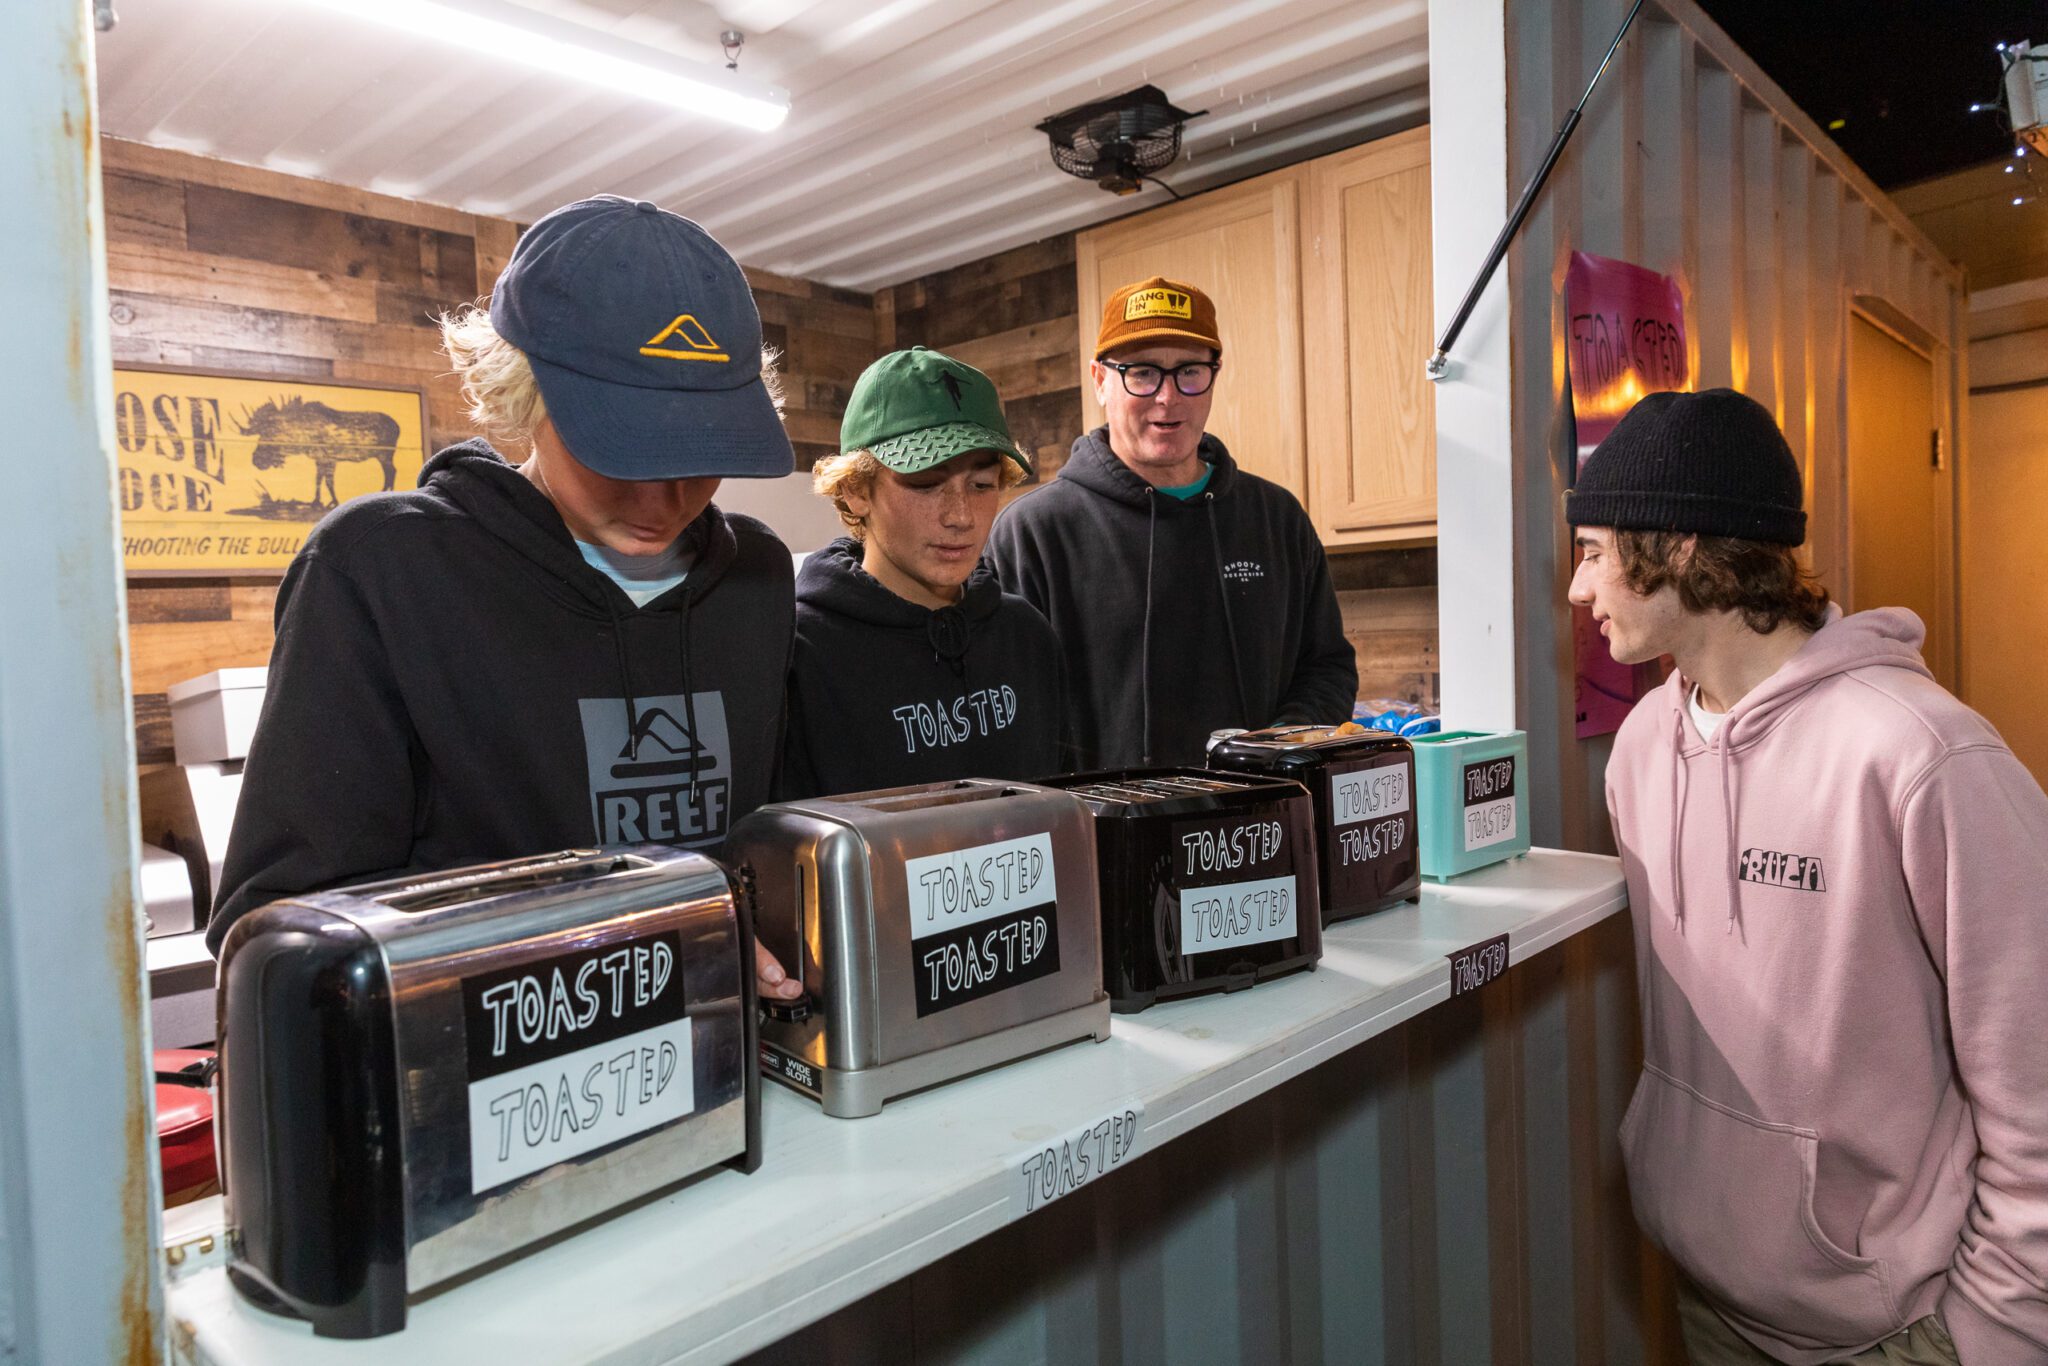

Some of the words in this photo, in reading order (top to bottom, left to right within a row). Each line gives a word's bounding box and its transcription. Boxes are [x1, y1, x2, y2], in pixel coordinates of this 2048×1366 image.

[1130, 292, 1164, 304] HANG
[115, 391, 225, 485] OSE
[123, 535, 212, 557] HOOTING
[217, 536, 252, 556] THE
[257, 536, 300, 555] BULL
[1224, 561, 1261, 572] SHOOTZ
[893, 684, 1017, 753] TOASTED
[1339, 773, 1405, 819] TOASTED
[1467, 760, 1512, 800] TOASTED
[603, 784, 726, 843] REEF
[1468, 803, 1512, 843] TOASTED
[1182, 821, 1283, 876] TOASTED
[1339, 818, 1405, 866] TOASTED
[920, 847, 1044, 921] TOASTED
[1191, 888, 1290, 943] TOASTED
[924, 916, 1048, 1001] TOASTED
[1455, 941, 1506, 996] TOASTED
[481, 941, 674, 1057] TOASTED
[785, 1066, 813, 1087] SLOTS
[786, 1057, 811, 1077] WIDE
[489, 1040, 678, 1162] TOASTED
[1022, 1110, 1137, 1213] TOASTED
